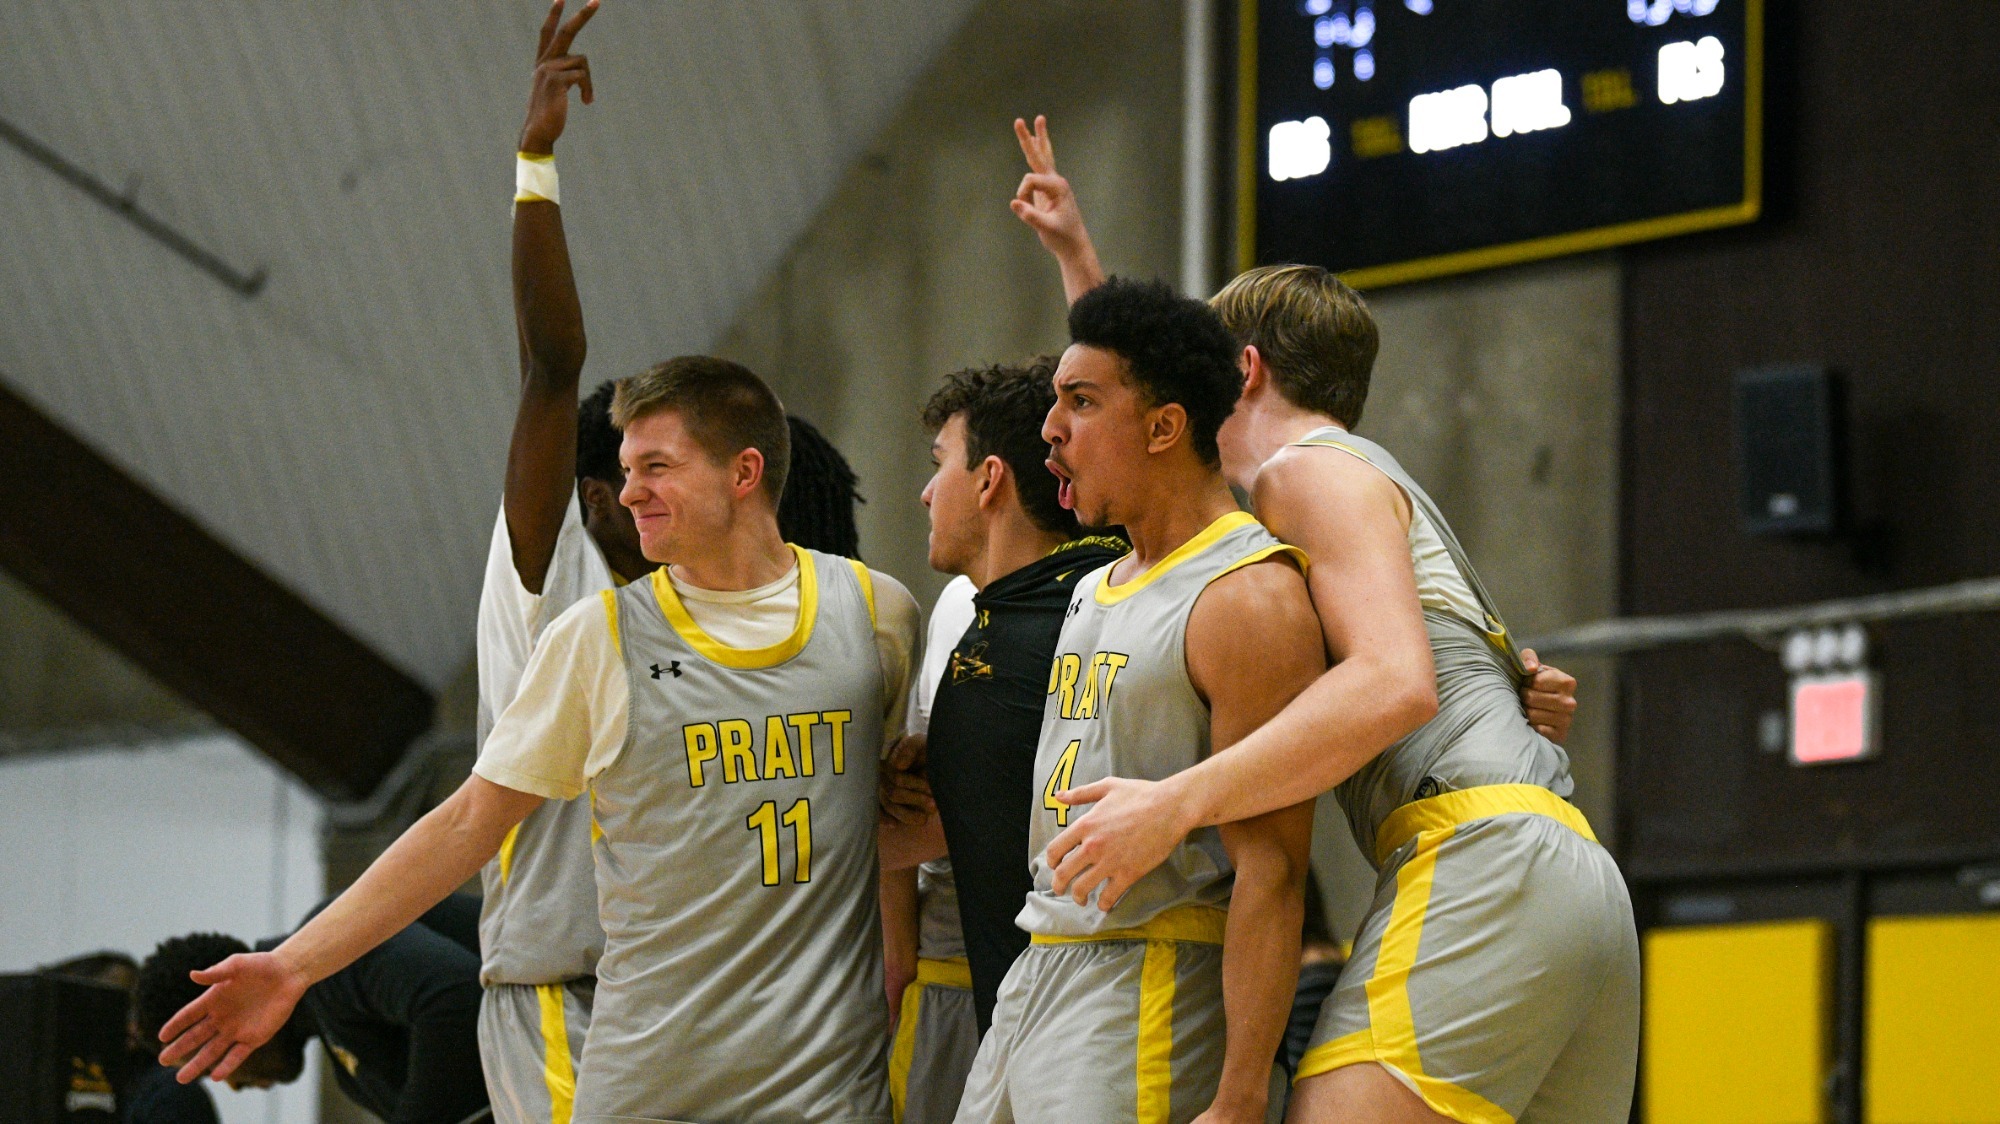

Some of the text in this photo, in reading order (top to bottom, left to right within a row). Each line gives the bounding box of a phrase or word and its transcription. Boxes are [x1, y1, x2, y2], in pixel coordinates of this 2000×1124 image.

[683, 709, 852, 788] PRATT
[1043, 739, 1081, 827] 4
[747, 797, 813, 886] 11
